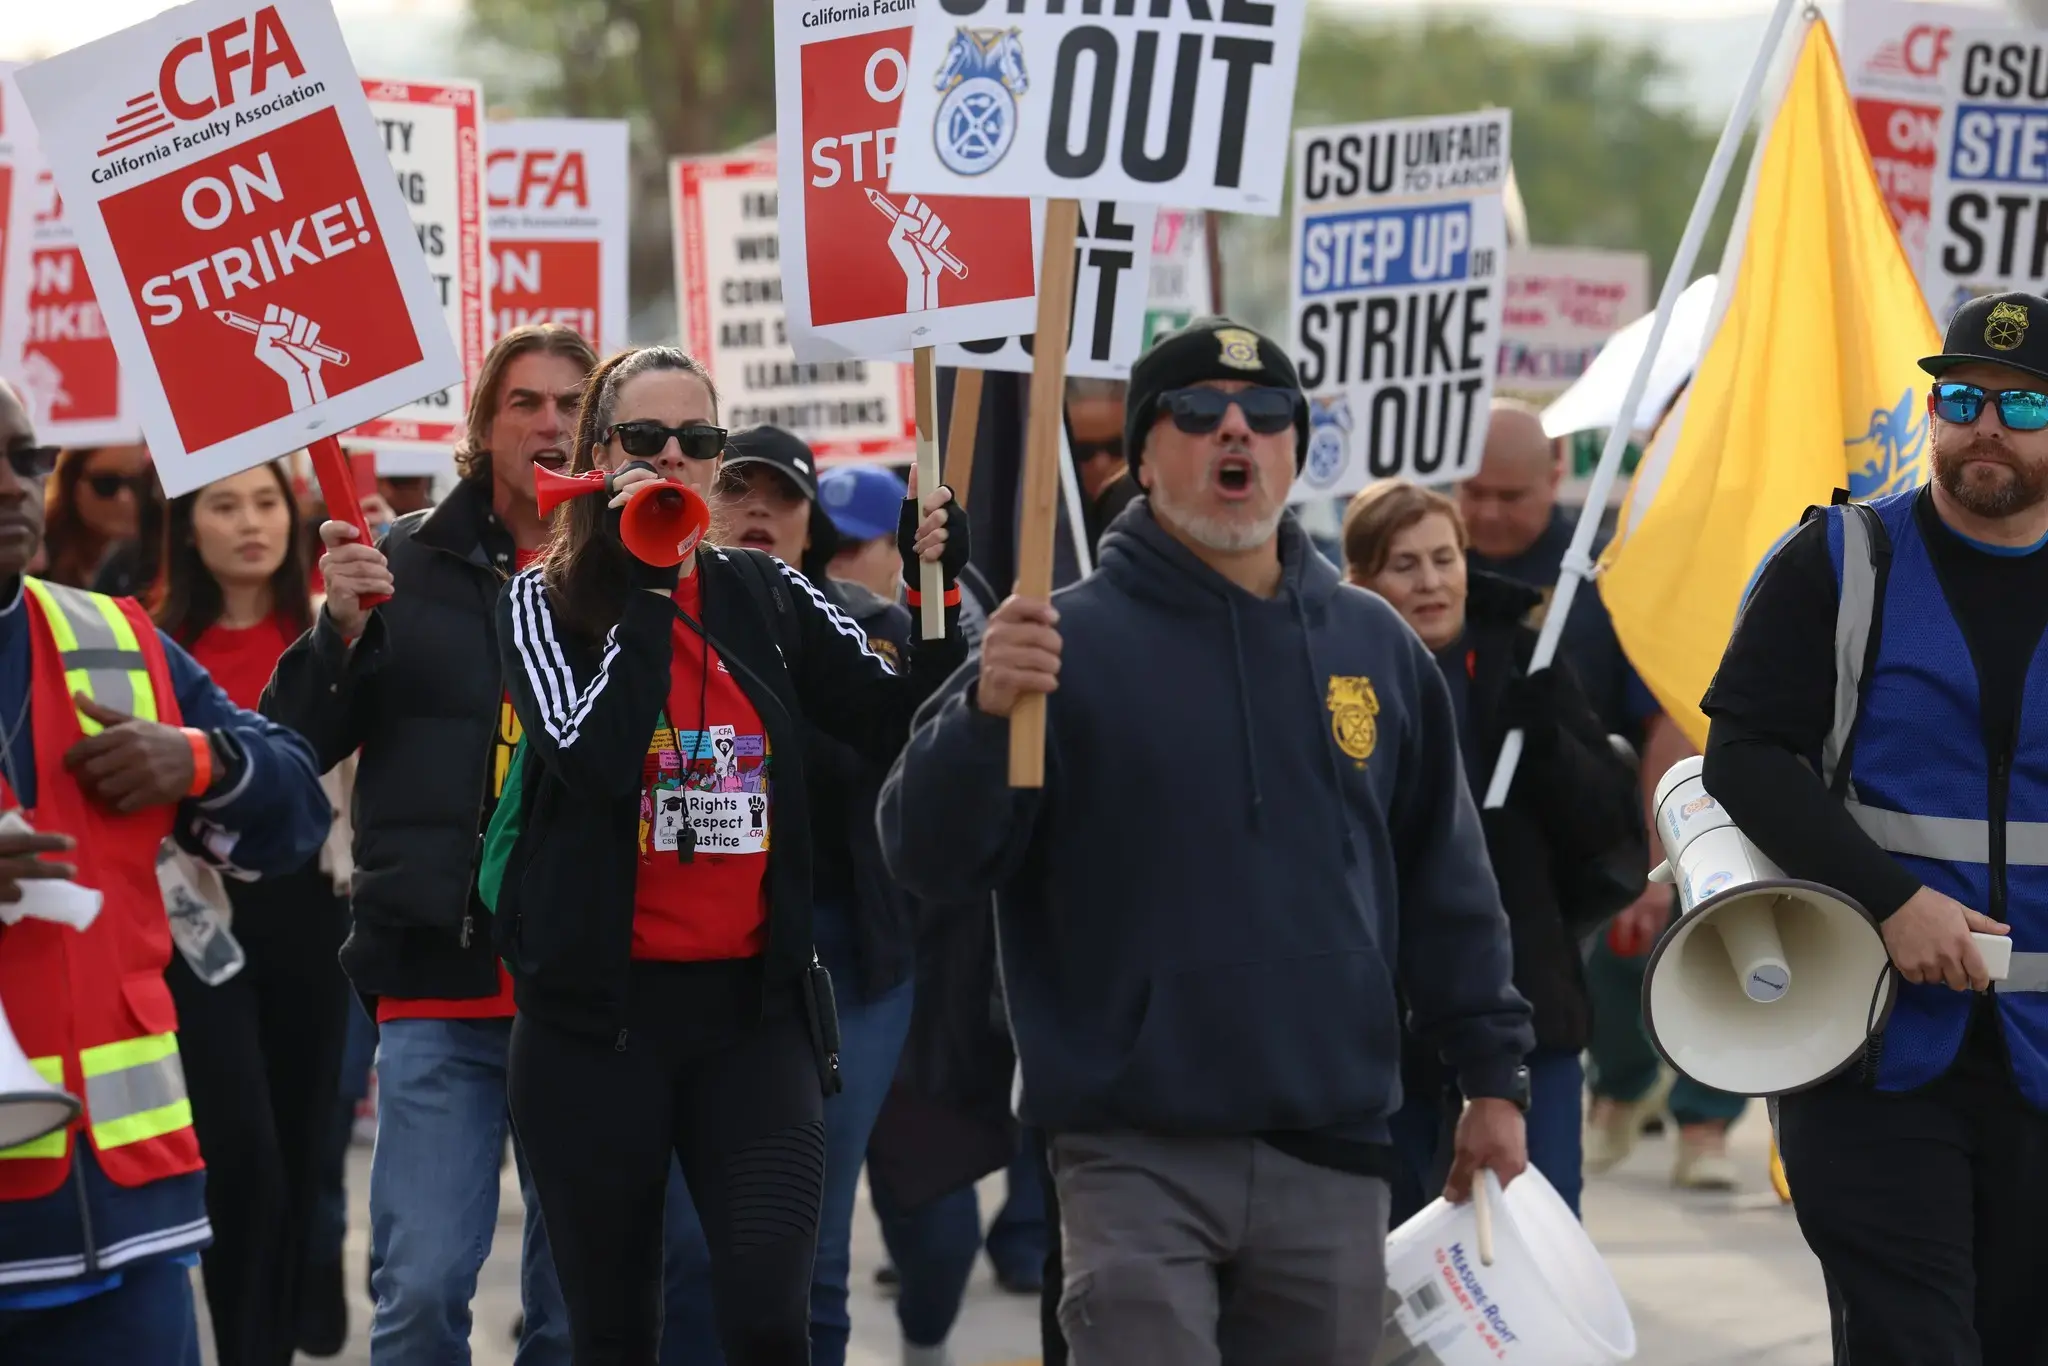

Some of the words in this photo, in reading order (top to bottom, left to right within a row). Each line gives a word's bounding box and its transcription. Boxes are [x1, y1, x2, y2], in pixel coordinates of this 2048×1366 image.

[802, 3, 870, 27] California
[1903, 23, 1954, 77] CF
[159, 4, 306, 121] CFA
[864, 47, 908, 103] O
[91, 144, 171, 184] California
[172, 119, 231, 152] Faculty
[235, 81, 326, 127] Association
[1045, 25, 1274, 189] OUT
[486, 149, 589, 209] CFA
[1305, 133, 1396, 200] CSU
[1405, 122, 1501, 167] UNFAIR
[1405, 172, 1431, 191] TO
[1955, 111, 2048, 180] STE
[181, 151, 284, 230] ON
[141, 196, 371, 326] STRIKE!
[1304, 216, 1405, 291] STEP
[1410, 210, 1468, 281] UP
[1299, 287, 1488, 390] STRIKE
[1369, 378, 1482, 478] OUT
[689, 797, 737, 814] Rights
[696, 833, 740, 847] ustice
[749, 829, 764, 838] CFA
